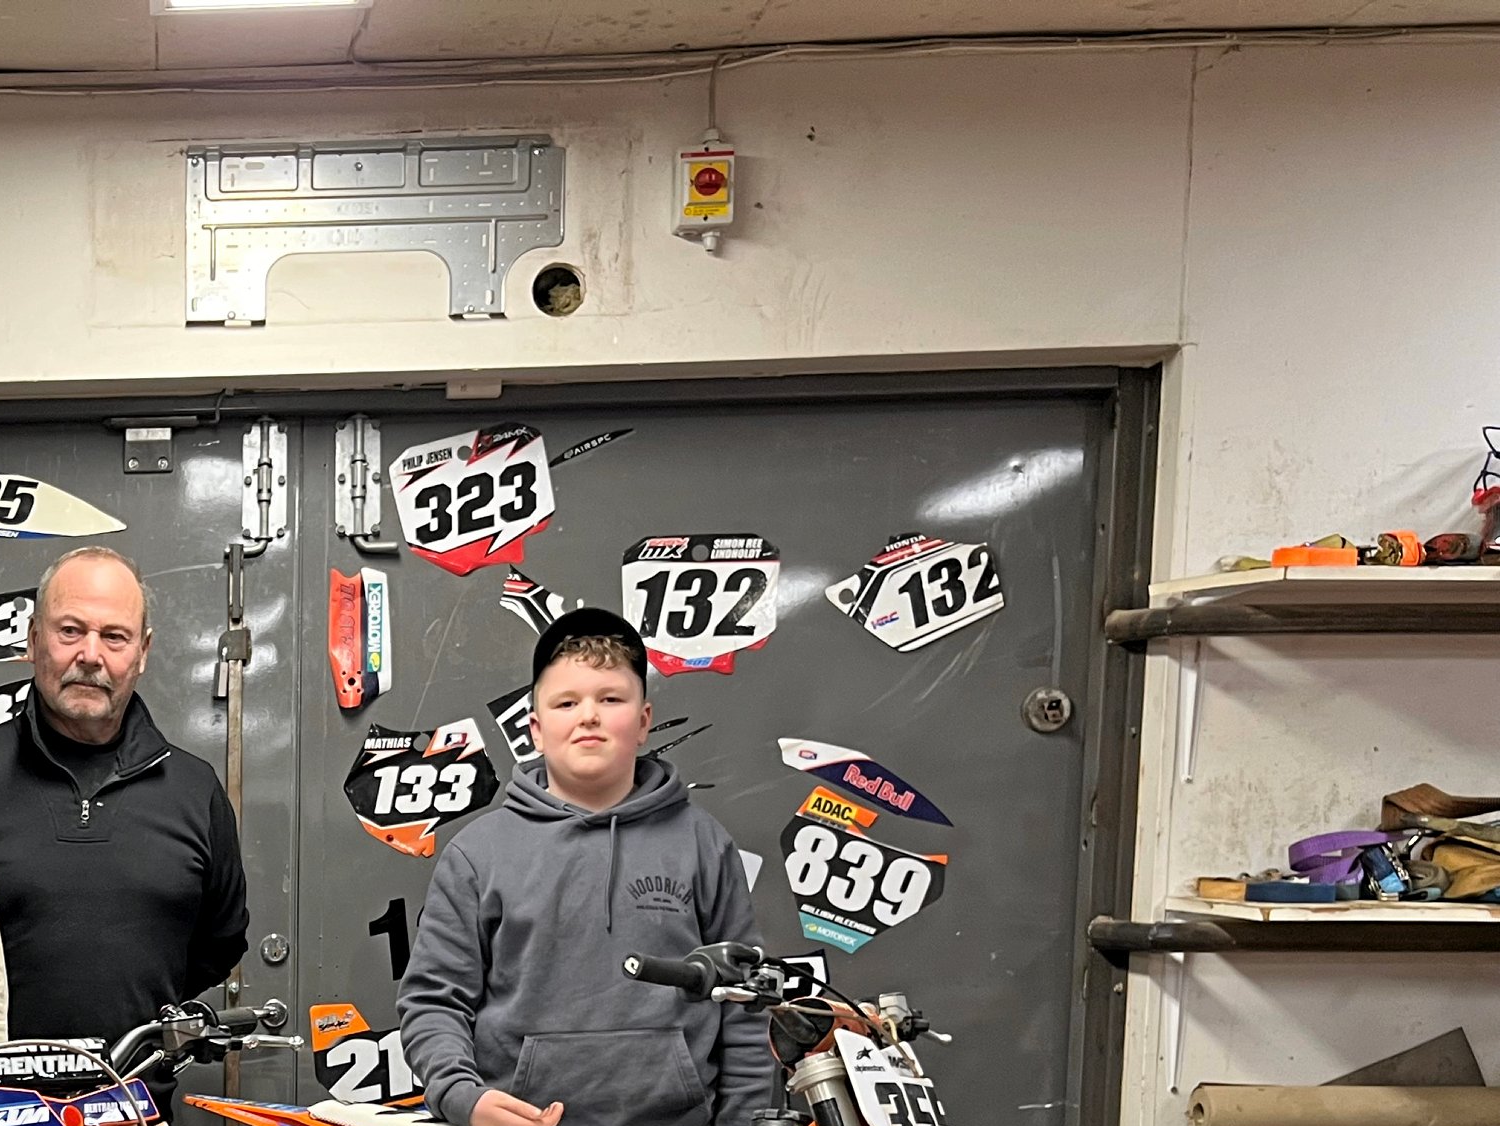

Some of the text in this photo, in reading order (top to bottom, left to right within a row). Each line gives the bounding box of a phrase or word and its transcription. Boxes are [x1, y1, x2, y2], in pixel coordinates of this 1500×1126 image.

[402, 447, 452, 472] PHILIP JENSEN
[415, 461, 537, 544] 323
[713, 539, 763, 549] SIMON REE
[885, 534, 926, 552] HONDA
[635, 568, 768, 638] 132
[899, 549, 1000, 629] 132
[367, 584, 381, 653] MOTOREX
[364, 737, 412, 750] MATHIAS
[373, 763, 477, 815] 133
[811, 797, 853, 821] ADAC
[843, 764, 915, 812] Red Bull
[627, 875, 694, 905] HOODRICH
[785, 825, 932, 926] 839
